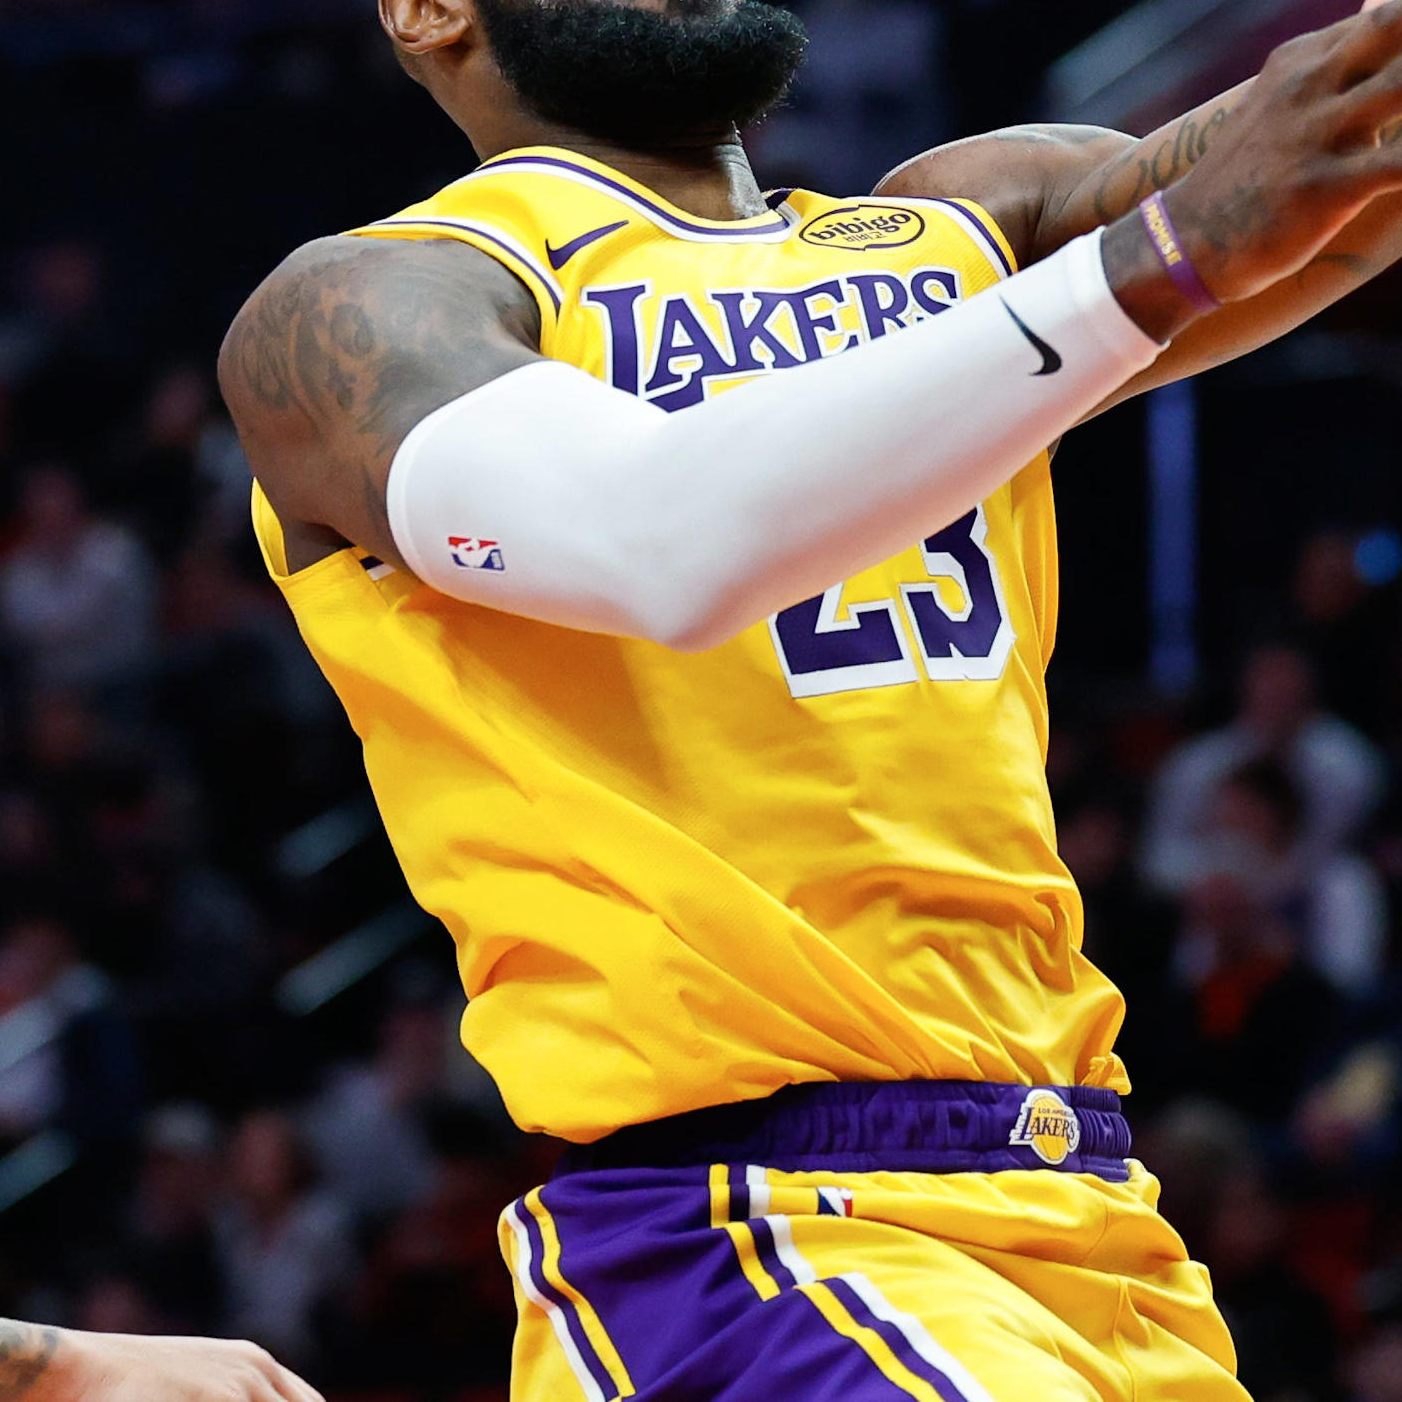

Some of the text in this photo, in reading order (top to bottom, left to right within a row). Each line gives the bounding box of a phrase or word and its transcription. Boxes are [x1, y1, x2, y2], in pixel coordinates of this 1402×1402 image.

[808, 213, 911, 241] bibigo
[582, 266, 961, 414] LAKERS
[767, 501, 1017, 699] 23
[1013, 1106, 1077, 1149] LAKERS
